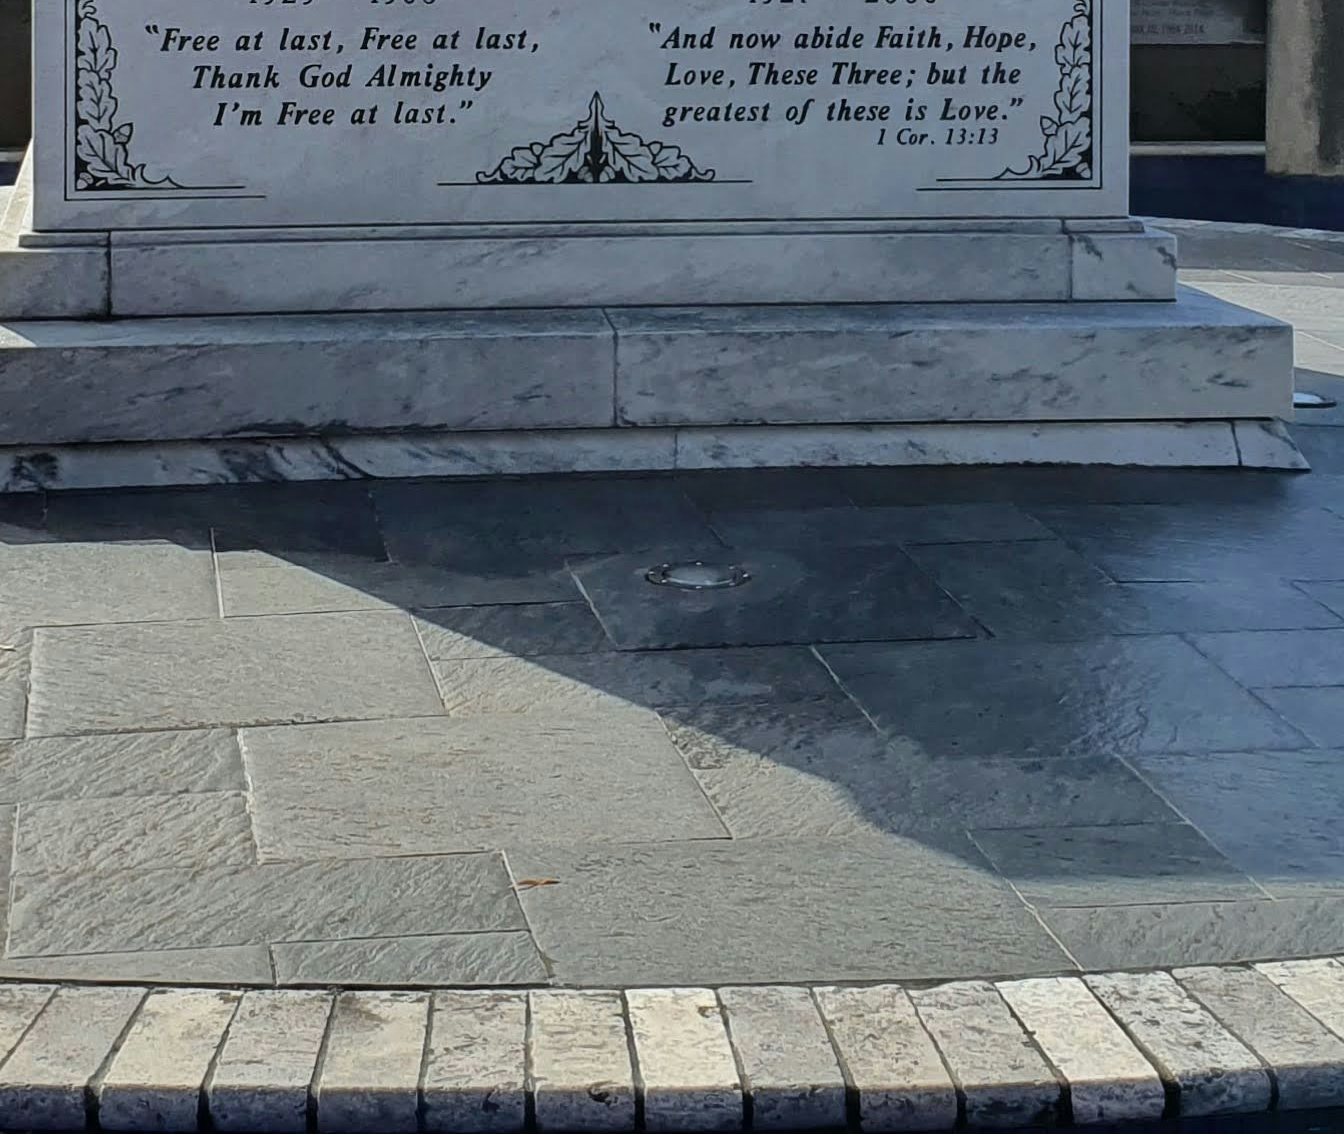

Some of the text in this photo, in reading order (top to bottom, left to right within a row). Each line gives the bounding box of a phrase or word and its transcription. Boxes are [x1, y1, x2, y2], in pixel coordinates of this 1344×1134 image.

[235, 31, 264, 52] at
[279, 27, 344, 55] last,
[358, 26, 418, 52] Free
[432, 29, 462, 51] at
[475, 26, 539, 53] last,
[729, 33, 782, 50] now
[793, 25, 865, 50] abide
[873, 25, 954, 53] Faith,
[962, 25, 1038, 54] Hope,
[191, 62, 494, 94] Thank God Almighty
[664, 61, 1022, 90] Love, These Three; but the
[276, 101, 336, 127] Free
[350, 104, 379, 126] at
[661, 102, 771, 129] greatest
[785, 98, 817, 127] of
[826, 98, 892, 123] these
[904, 97, 928, 122] is
[896, 127, 936, 147] Cor.
[945, 127, 1000, 147] 13:13
